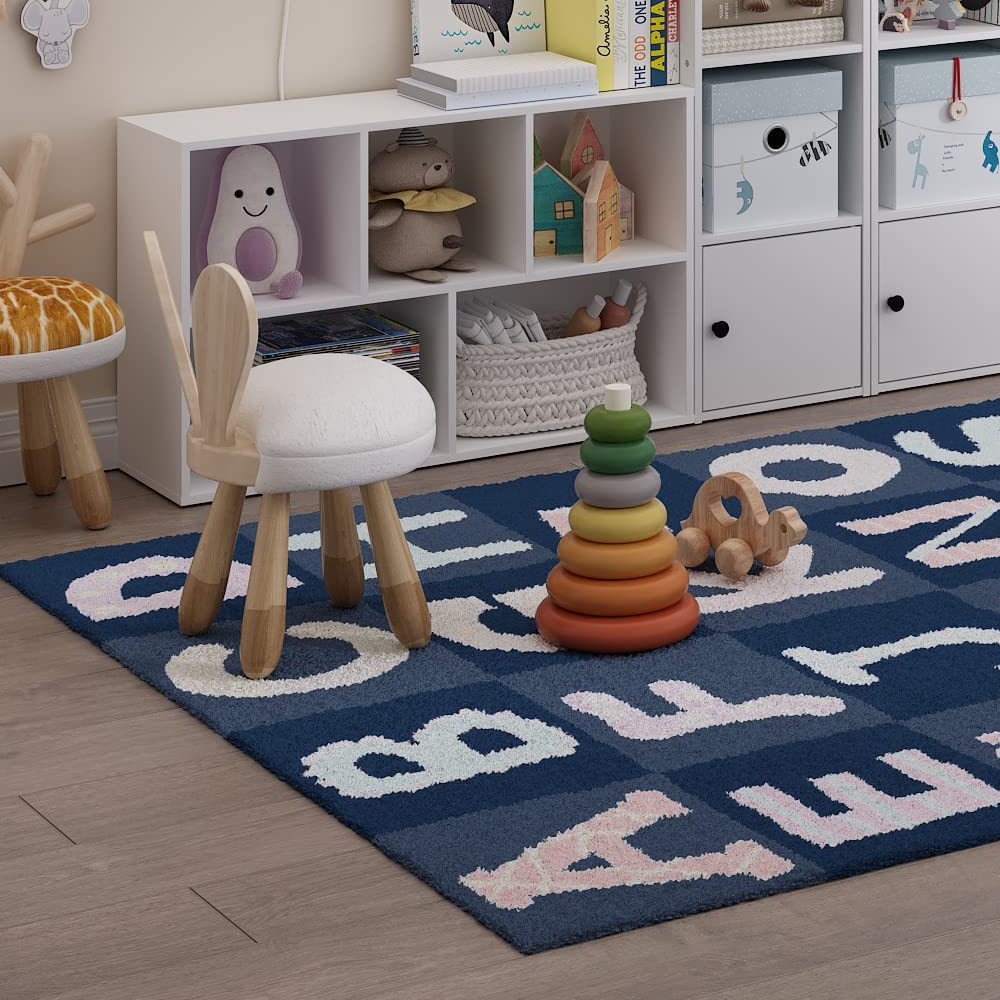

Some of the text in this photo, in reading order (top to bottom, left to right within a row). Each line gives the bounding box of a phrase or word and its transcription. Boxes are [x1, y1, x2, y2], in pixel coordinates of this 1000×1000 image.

[597, 4, 610, 57] Amelia
[635, 0, 646, 24] ONE
[650, 1, 665, 71] ALPHA
[634, 36, 646, 60] ODD
[635, 64, 646, 87] THE
[708, 443, 901, 497] O
[165, 620, 410, 698] C
[561, 679, 847, 741] F
[301, 707, 580, 798] B
[458, 790, 796, 911] A
